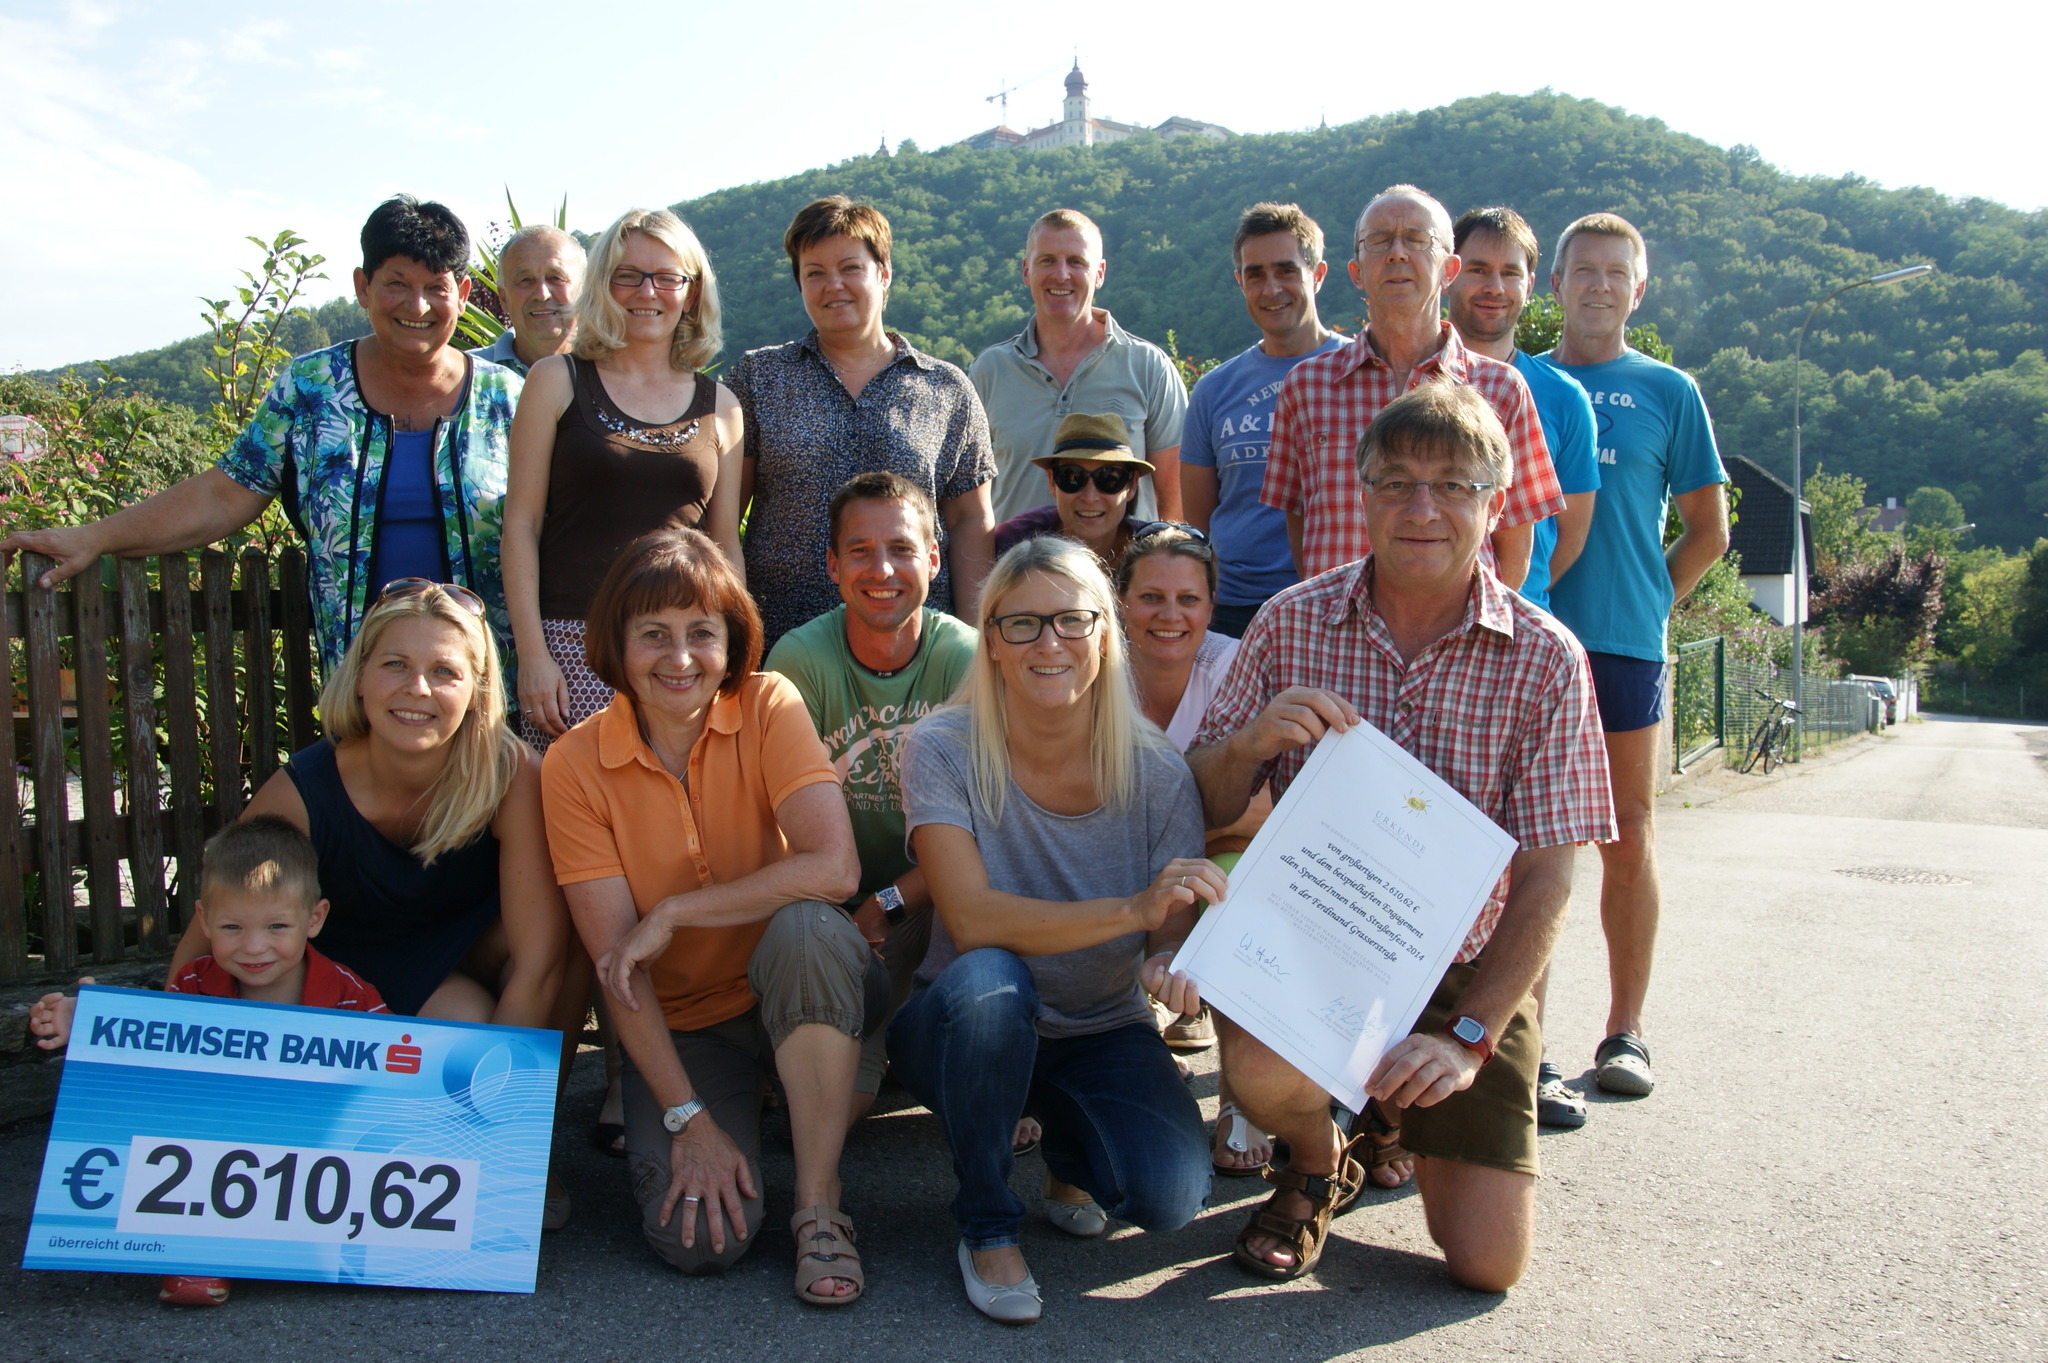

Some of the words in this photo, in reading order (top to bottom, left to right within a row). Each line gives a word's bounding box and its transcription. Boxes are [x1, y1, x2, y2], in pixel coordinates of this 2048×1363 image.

[1246, 380, 1285, 407] NEW
[1608, 392, 1636, 409] CO.
[1374, 809, 1427, 854] URKUNDE
[1279, 854, 1299, 869] allen
[1297, 866, 1349, 905] SpenderInnen
[1348, 900, 1367, 917] beim
[1365, 914, 1406, 947] Straßenfest
[1405, 944, 1425, 961] 2014
[1300, 846, 1320, 859] und
[1315, 857, 1332, 871] dem
[1332, 867, 1382, 906] beispielhaften
[1381, 903, 1423, 938] Engagement
[1327, 842, 1342, 855] von
[1338, 853, 1382, 884] großartigen
[1381, 881, 1413, 907] 2.610,62
[1412, 905, 1420, 913] €
[1288, 882, 1298, 892] in
[1297, 889, 1312, 900] der
[1311, 897, 1353, 927] Ferdinand
[1348, 924, 1397, 962] Grasserstraße
[90, 1016, 269, 1061] KREMSER
[279, 1034, 381, 1071] BANK
[61, 1147, 120, 1210] €
[135, 1144, 461, 1240] 2.610,62
[49, 1236, 119, 1250] überreicht
[124, 1240, 166, 1253] durch:
